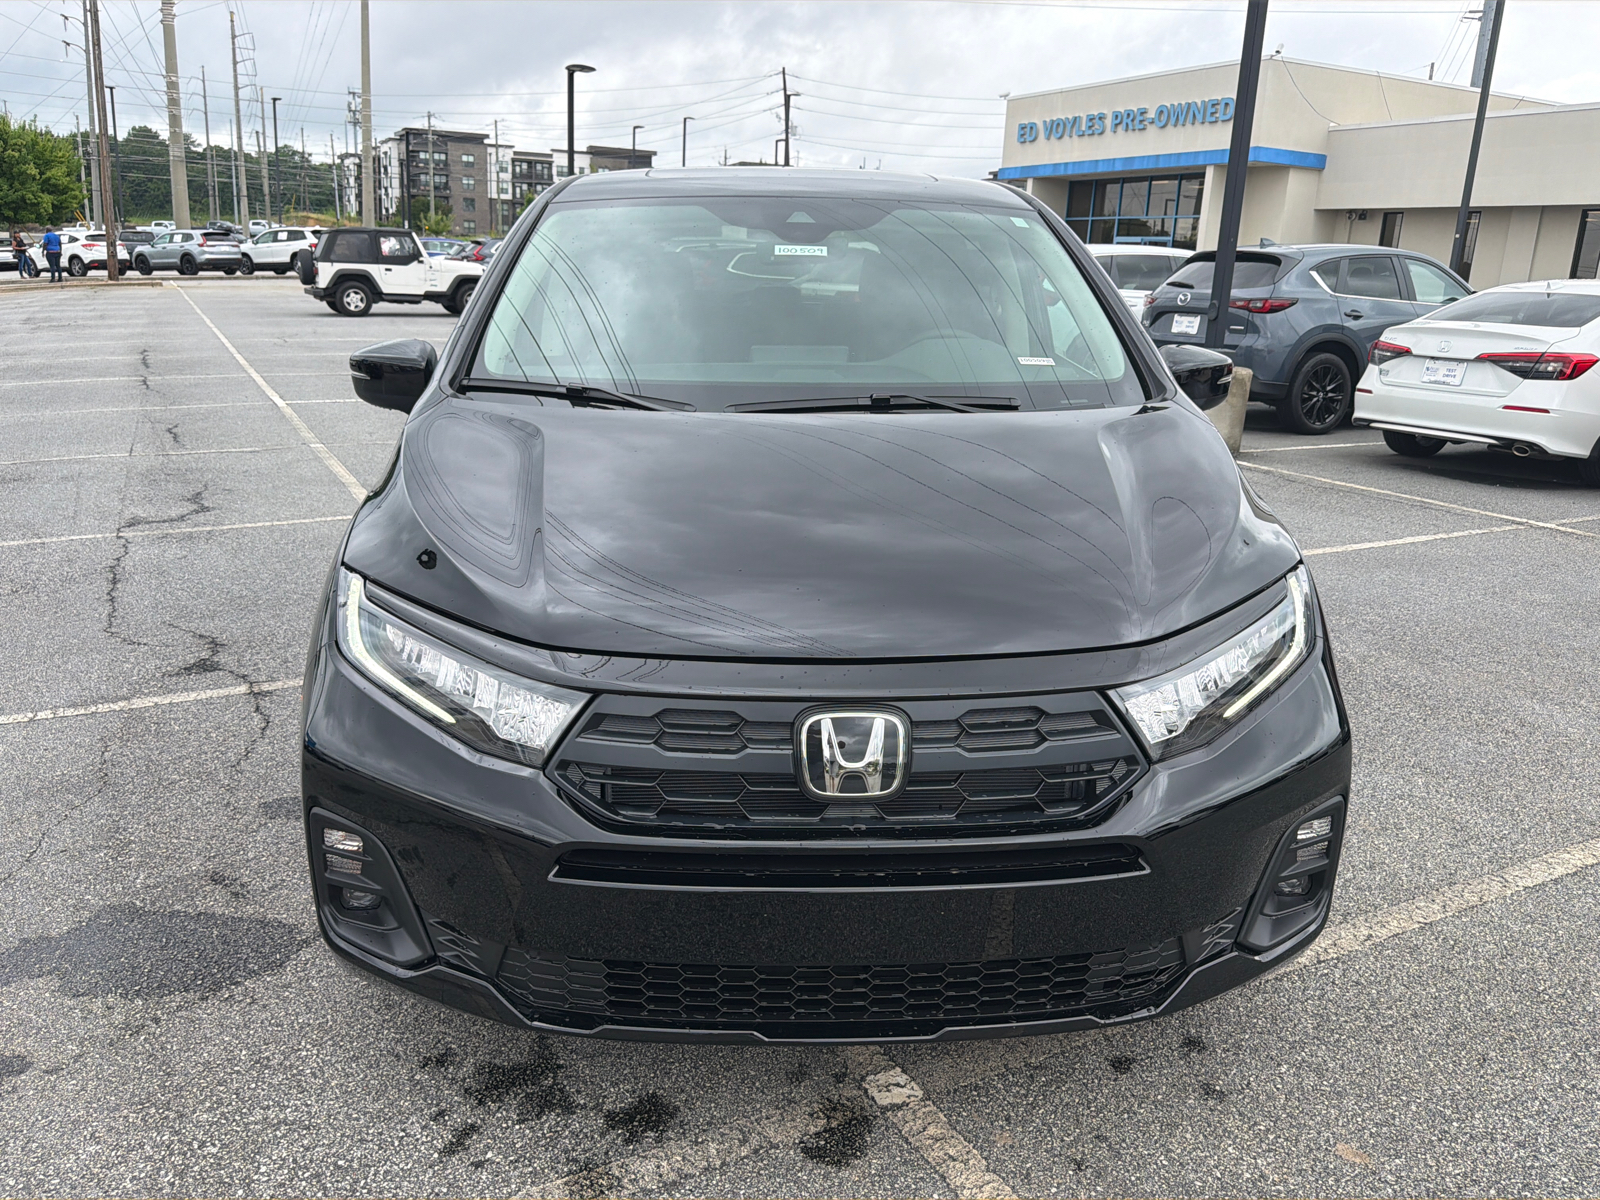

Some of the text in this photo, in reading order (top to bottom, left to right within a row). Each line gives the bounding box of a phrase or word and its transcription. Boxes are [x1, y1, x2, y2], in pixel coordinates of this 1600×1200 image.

[1016, 97, 1235, 143] ED VOYLES PRE-OWNED
[778, 247, 824, 255] 100509
